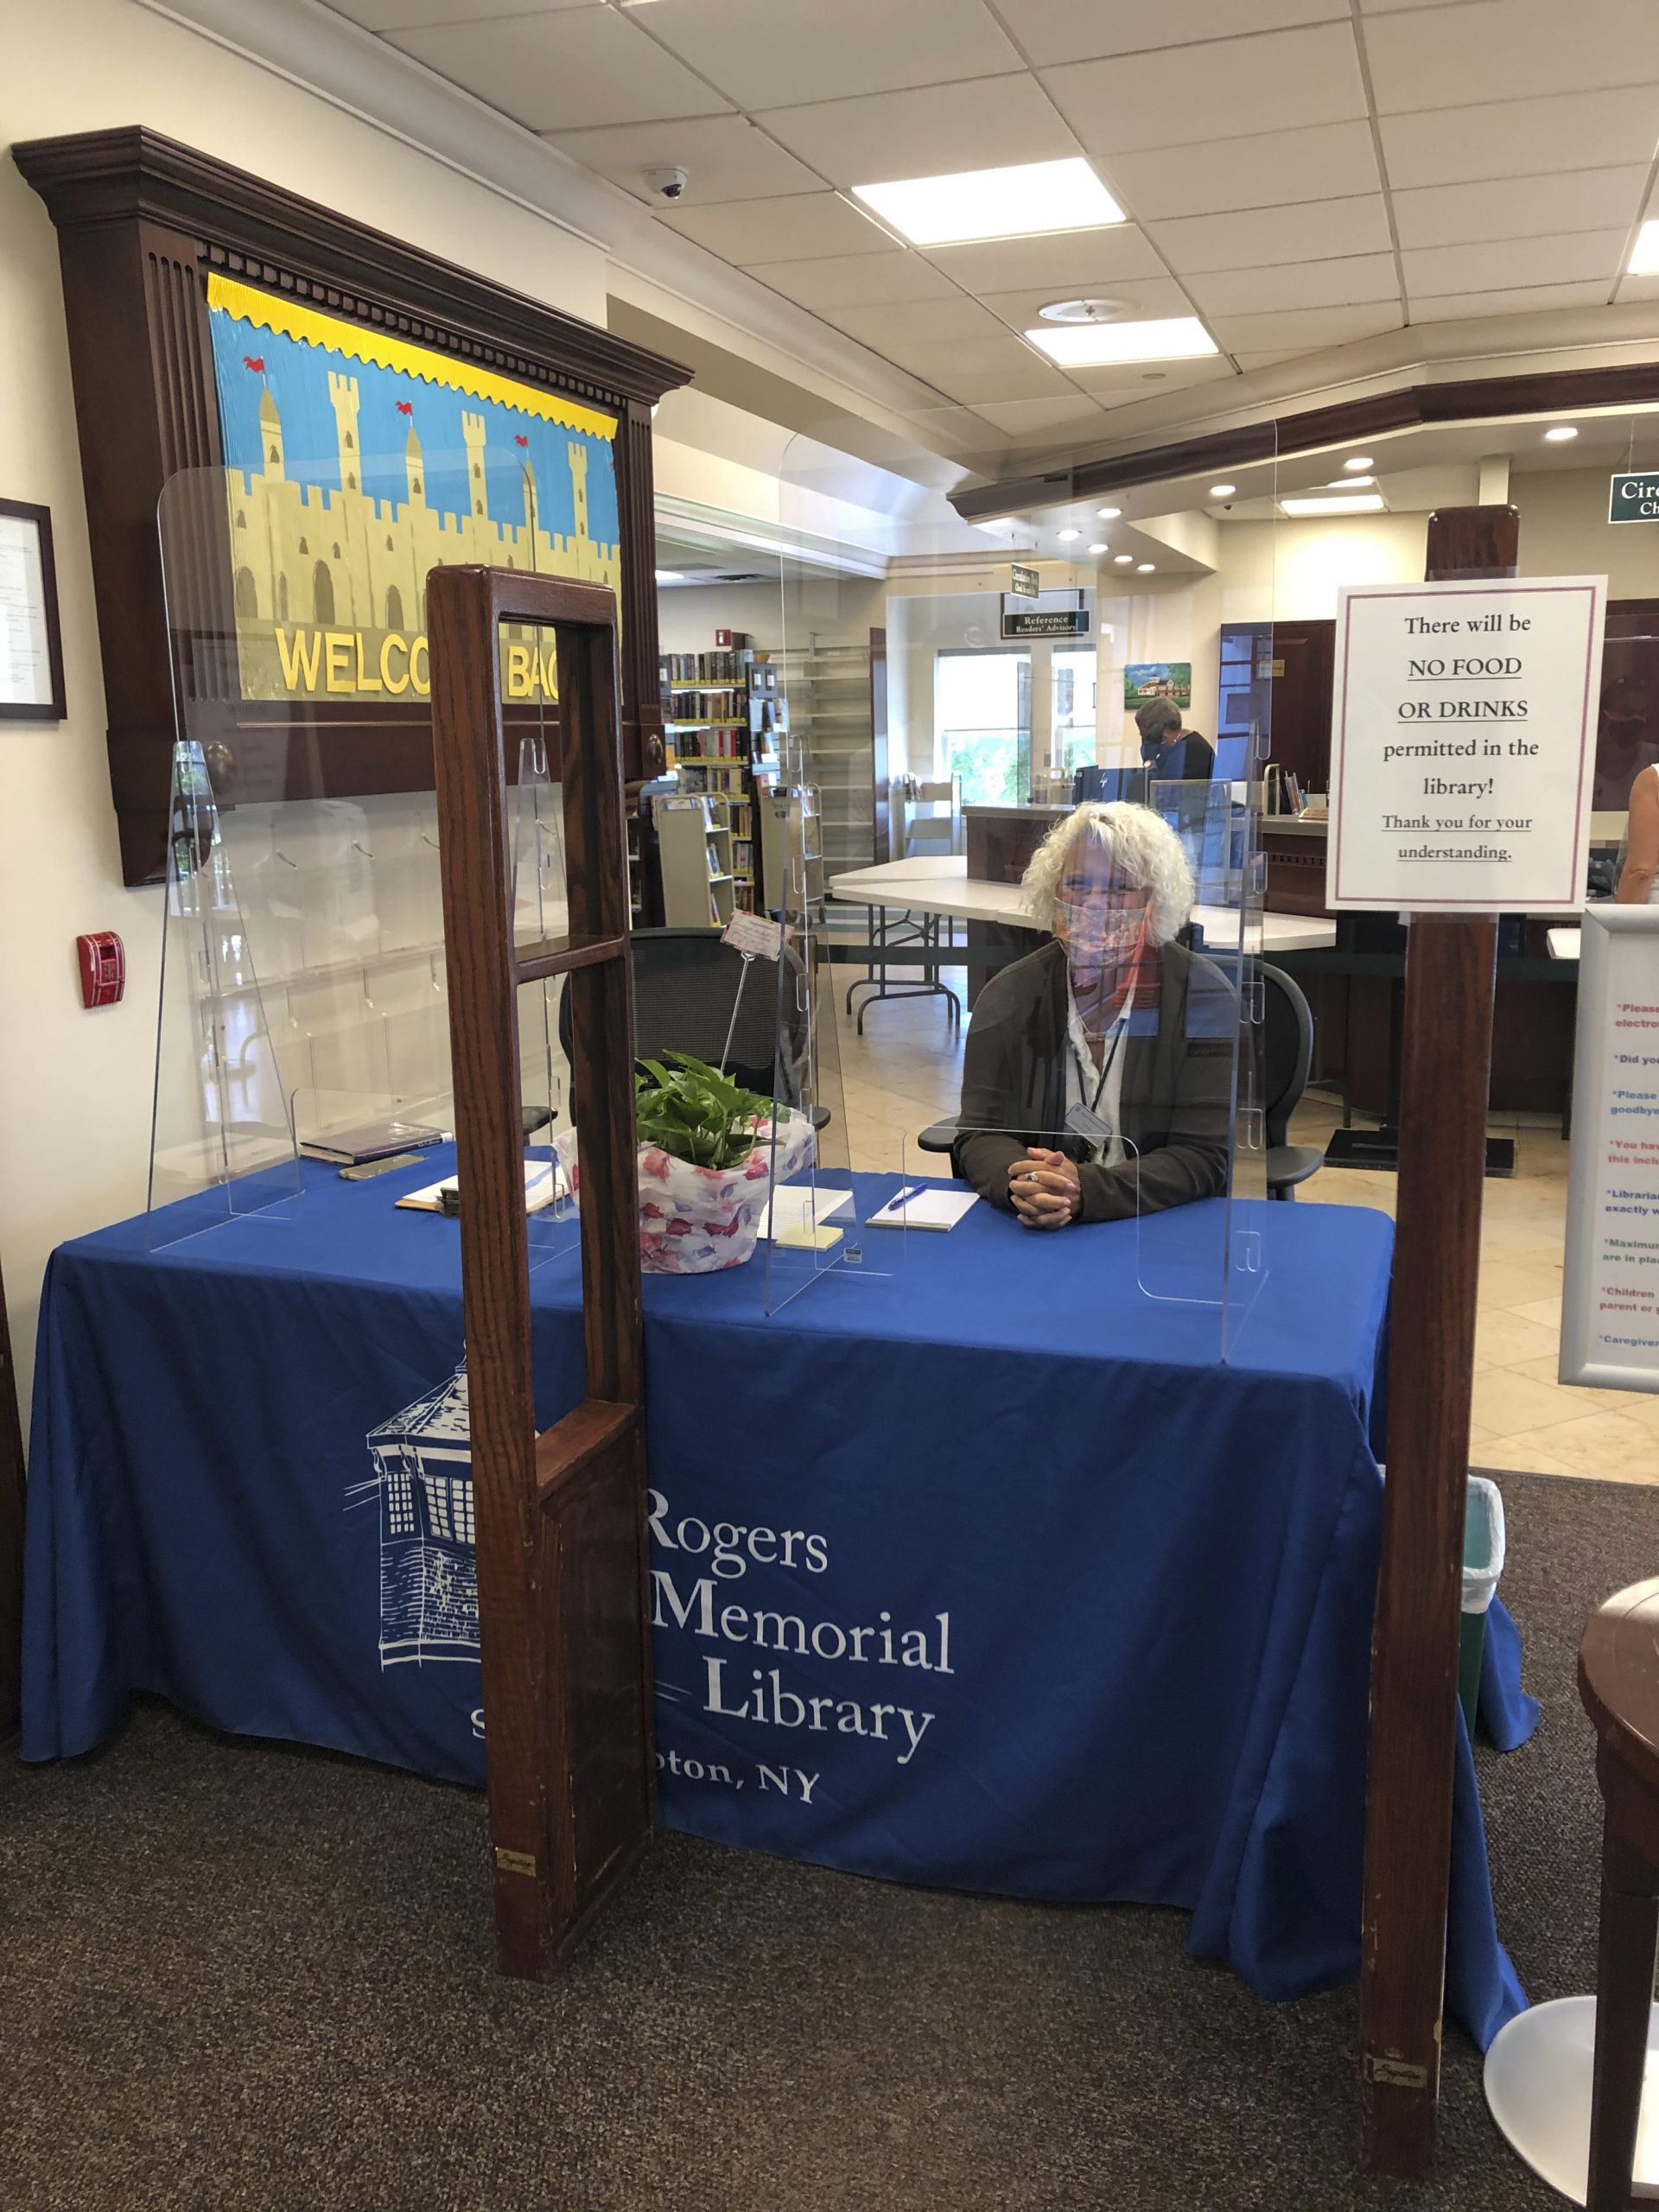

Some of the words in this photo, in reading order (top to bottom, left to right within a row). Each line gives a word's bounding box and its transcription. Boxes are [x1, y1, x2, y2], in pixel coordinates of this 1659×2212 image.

[1024, 616, 1069, 625] Reference
[1046, 624, 1076, 632] Advisory
[1405, 615, 1460, 634] There
[1466, 613, 1503, 632] will
[1509, 613, 1531, 632] be
[276, 628, 430, 695] WELCO
[1408, 659, 1445, 677] NO
[1452, 658, 1522, 676] FOOD
[1398, 702, 1432, 719] OR
[1438, 700, 1529, 718] DRINKS
[1382, 739, 1477, 761] permitted
[1483, 739, 1502, 756] in
[1508, 739, 1539, 756] the
[1423, 778, 1494, 798] library!
[1382, 815, 1430, 830] Thank
[1434, 817, 1463, 832] you
[1468, 815, 1492, 830] for
[1496, 817, 1533, 832] your
[1398, 845, 1512, 861] understanding.
[1615, 1020, 1659, 1028] electro
[1608, 1154, 1630, 1163] this
[1633, 1155, 1659, 1166] inclu
[1607, 1189, 1659, 1200] Libraria
[1605, 1205, 1649, 1217] exactly
[1624, 1254, 1636, 1262] in
[1599, 1301, 1637, 1313] parent
[648, 1488, 828, 1580] Rogers
[650, 1569, 955, 1675] Memorial
[702, 1656, 935, 1764] Library
[755, 1764, 820, 1804] NY
